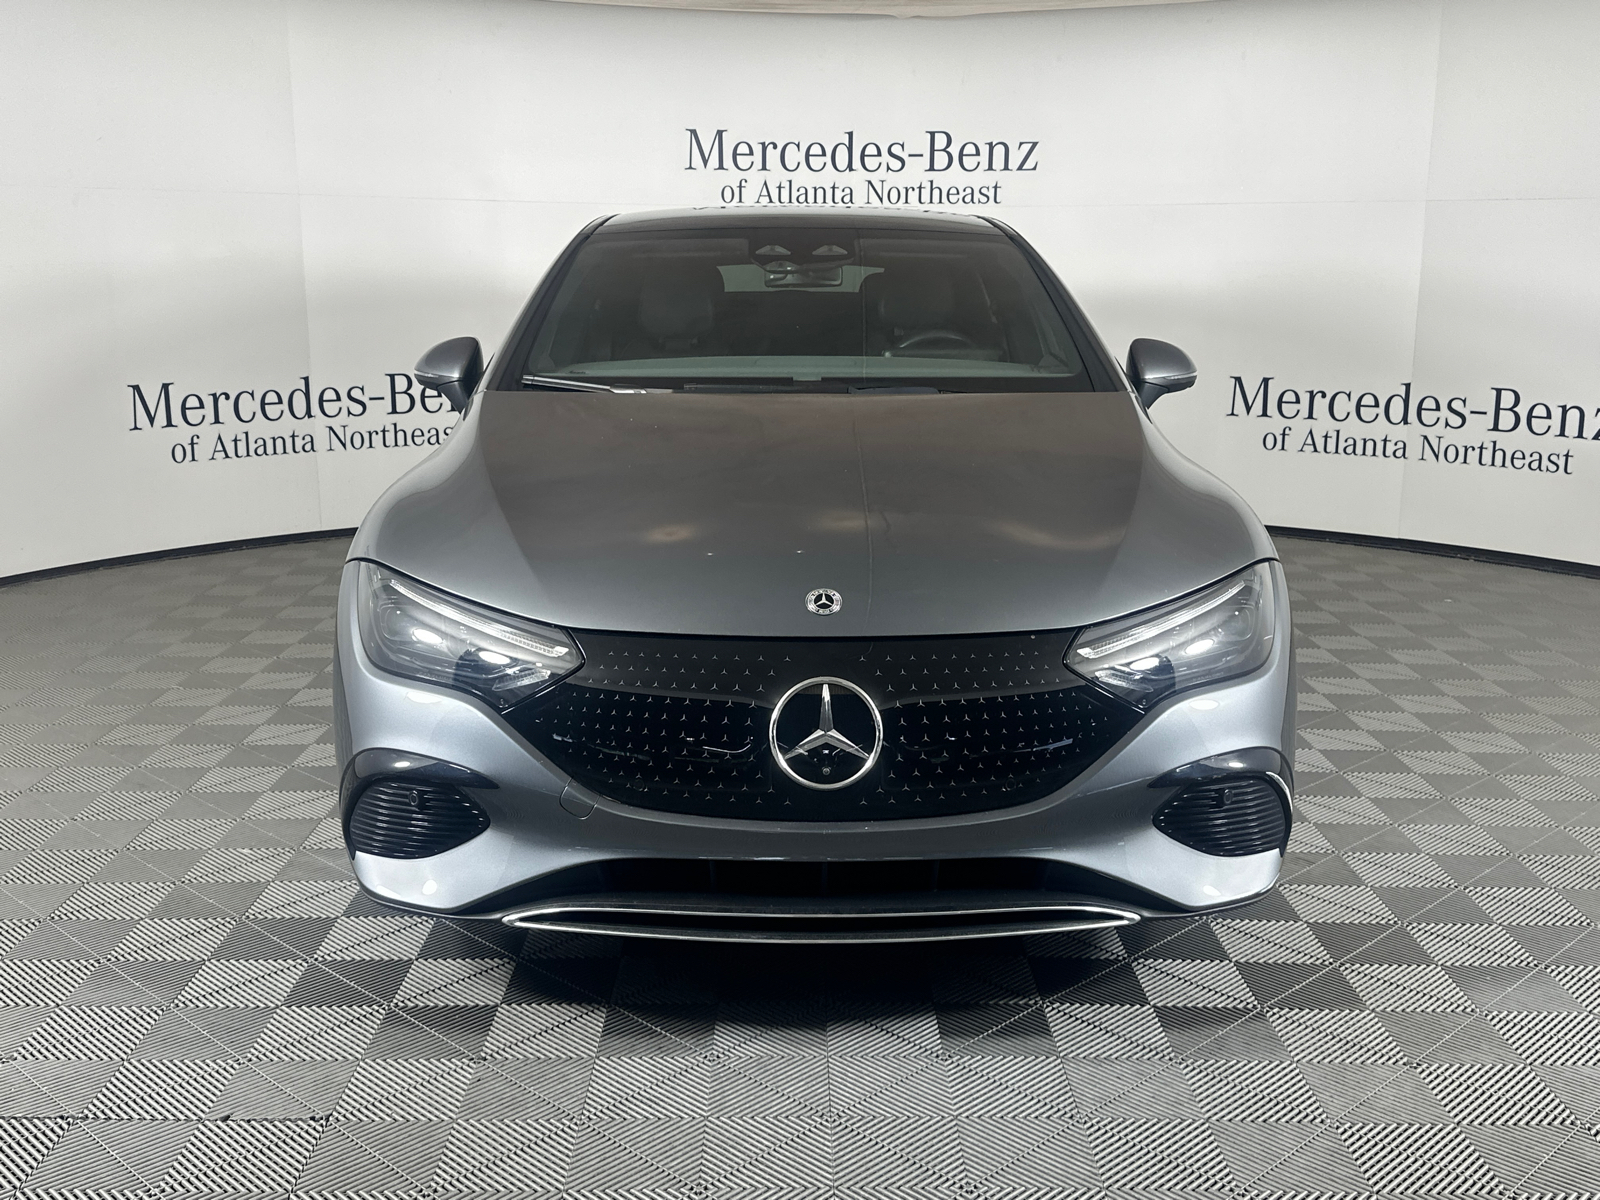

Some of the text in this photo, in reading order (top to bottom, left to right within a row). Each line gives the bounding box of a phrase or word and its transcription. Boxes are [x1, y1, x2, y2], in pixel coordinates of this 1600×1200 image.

[684, 128, 1040, 173] Mercedes-Benz
[720, 178, 1002, 205] of Atlanta Northeast
[127, 372, 457, 432] Mercedes-Be
[171, 434, 200, 464] of
[208, 430, 317, 461] Atlanta
[1262, 426, 1575, 475] of Atlanta Northeast
